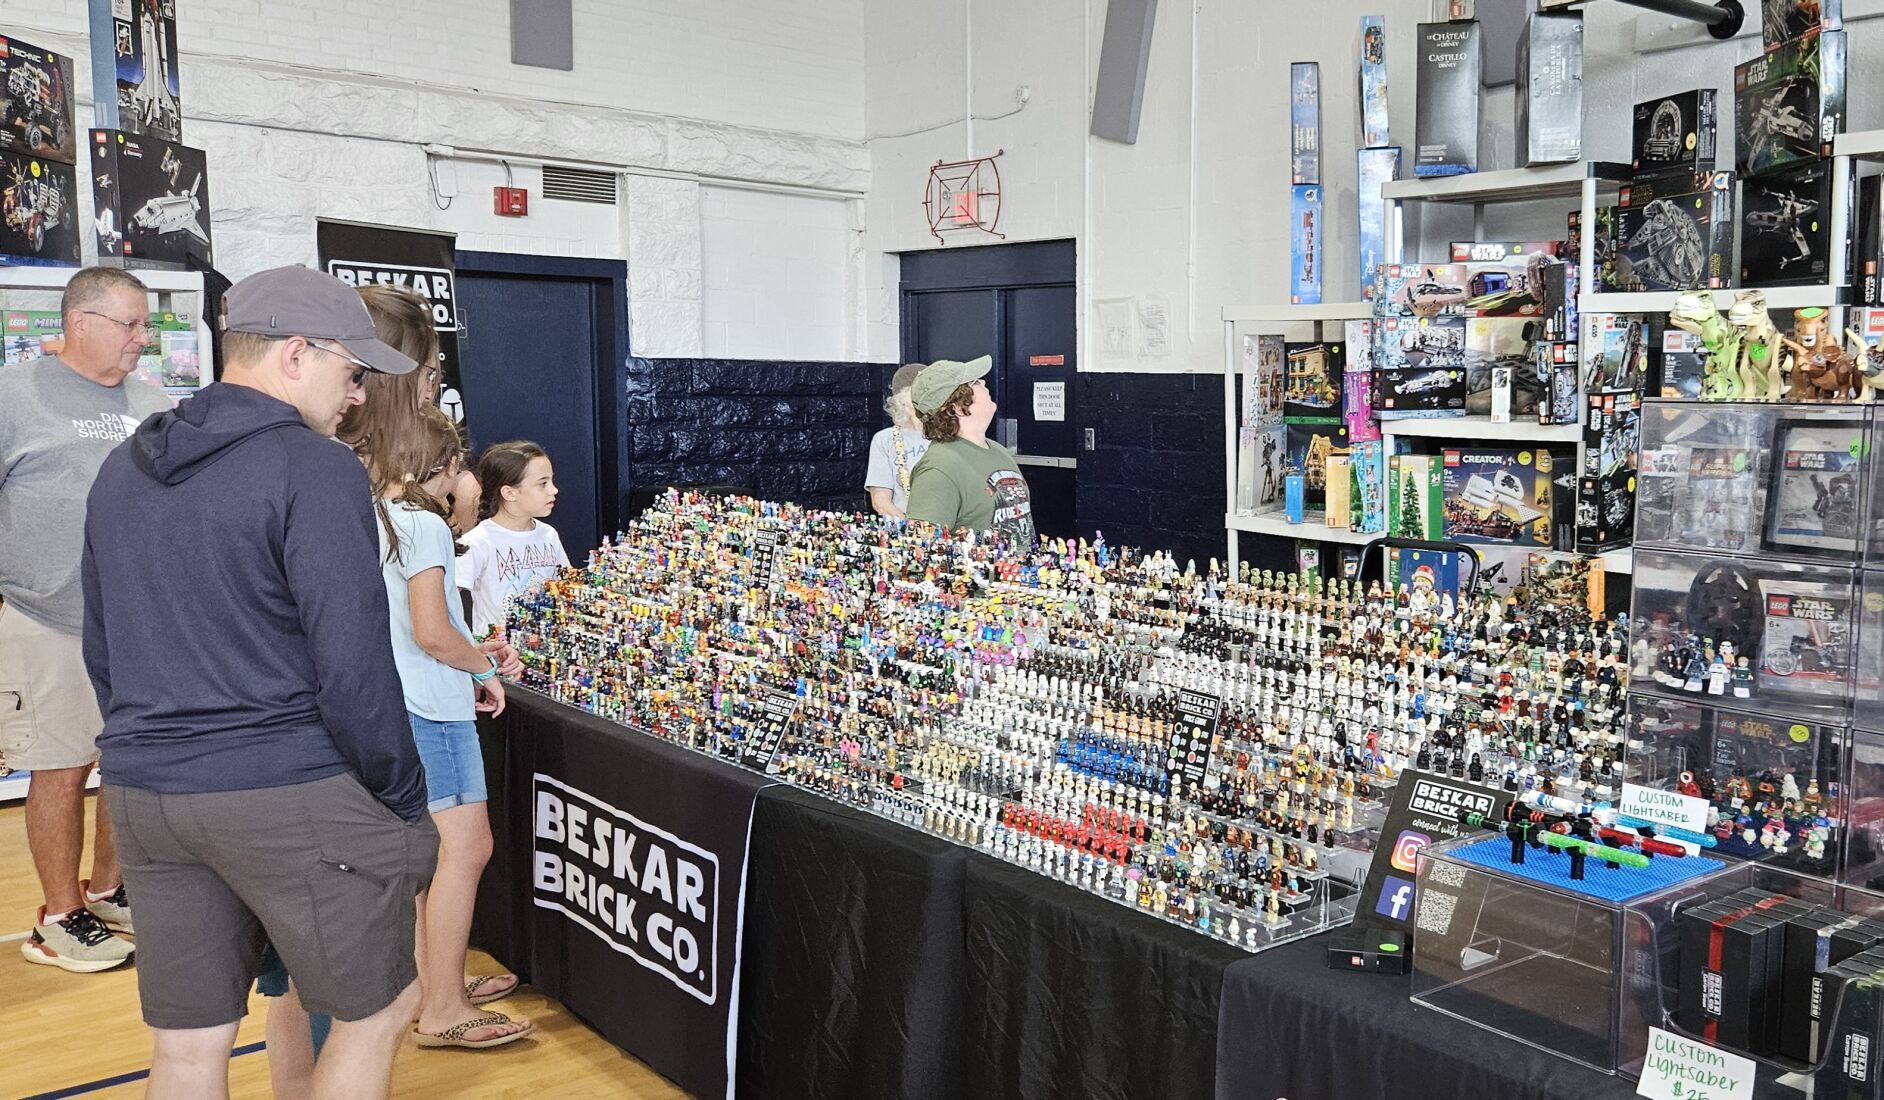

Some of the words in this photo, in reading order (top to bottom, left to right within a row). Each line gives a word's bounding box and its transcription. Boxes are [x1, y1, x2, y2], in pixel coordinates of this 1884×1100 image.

[9, 46, 42, 63] TECHNIC
[1428, 53, 1467, 62] CASTILLO
[1749, 60, 1769, 75] STAR
[1748, 69, 1769, 86] WARS
[1472, 251, 1504, 261] WARS
[10, 319, 27, 327] LEGO
[100, 412, 122, 424] DA
[71, 419, 124, 433] NORTH
[78, 428, 127, 442] SHORE
[1462, 454, 1503, 464] CREATOR
[1800, 453, 1826, 462] STAR
[1800, 460, 1826, 469] WARS
[1769, 601, 1788, 610] LEGO
[1792, 598, 1835, 611] STAR
[1792, 608, 1835, 620] WARS
[1180, 702, 1201, 713] BRICK
[1181, 694, 1216, 710] BESKAR
[1720, 720, 1737, 728] LEGO
[1741, 720, 1770, 730] STAR
[1741, 727, 1773, 738] WARS
[1417, 783, 1489, 812] BESKAR
[1638, 789, 1684, 808] CUSTOM
[1413, 797, 1459, 818] BRICK
[1622, 803, 1691, 824] LIGHTSABER
[1412, 818, 1441, 832] connect
[1440, 823, 1459, 838] with
[535, 790, 706, 923] BESKAR
[534, 850, 639, 943] BRICK
[646, 912, 705, 982] CO.
[1851, 1035, 1860, 1065] BRICK
[1856, 1036, 1868, 1078] BESKAR
